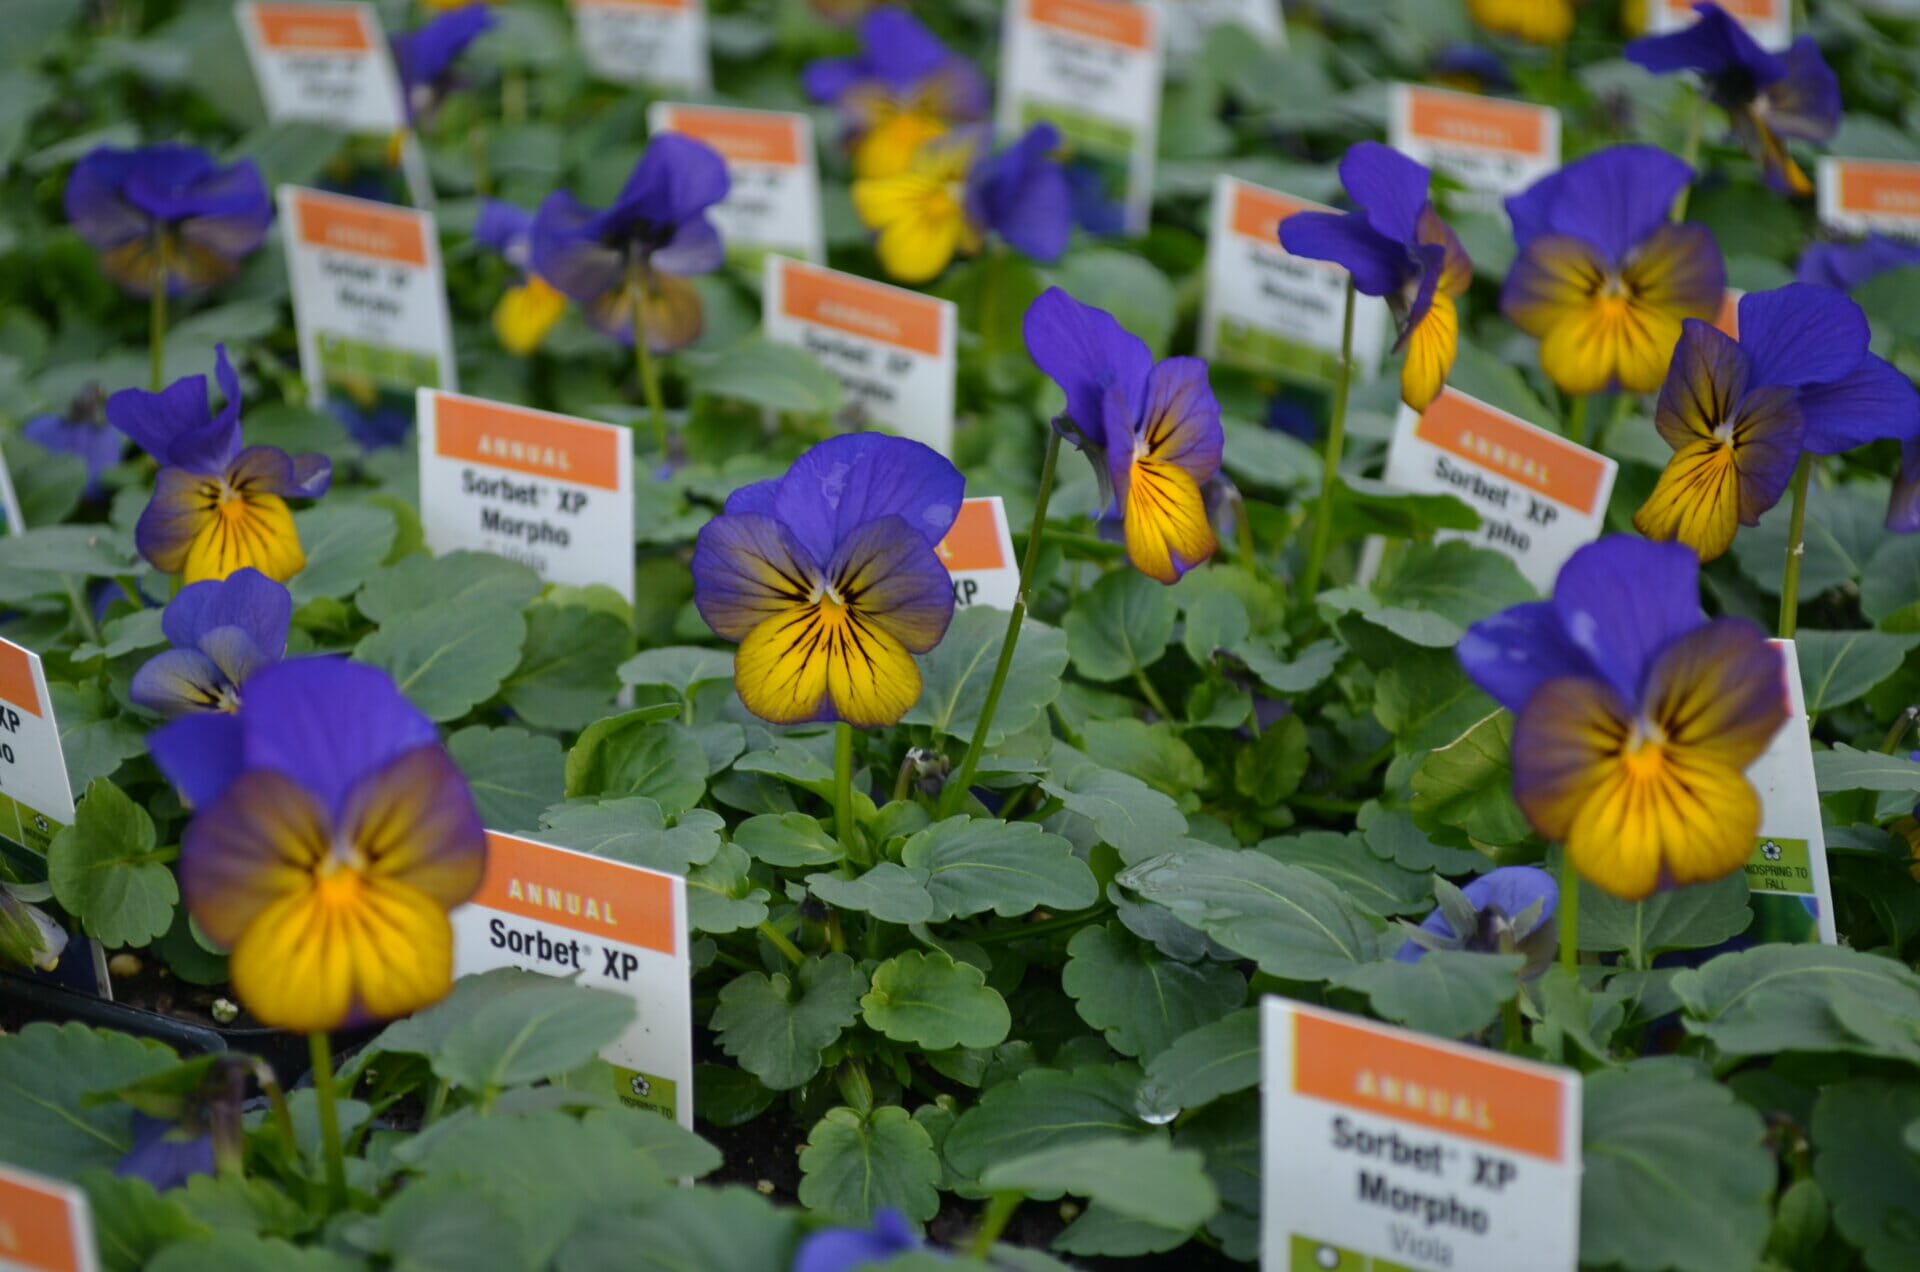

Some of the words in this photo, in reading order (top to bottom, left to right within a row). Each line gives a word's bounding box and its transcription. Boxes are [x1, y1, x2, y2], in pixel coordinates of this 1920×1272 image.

[477, 433, 571, 472] ANNUAL
[1460, 430, 1549, 485] ANNUAL
[558, 488, 588, 515] XP
[1526, 498, 1559, 528] XP
[480, 508, 571, 547] Morpho
[1765, 878, 1787, 891] FALL
[1795, 866, 1808, 879] TO
[508, 878, 618, 924] ANNUAL
[602, 947, 639, 982] XP
[1356, 1069, 1495, 1132] ANNUAL
[1472, 1154, 1517, 1192] XP
[1357, 1170, 1489, 1235] Morpho
[1389, 1222, 1453, 1268] Viola
